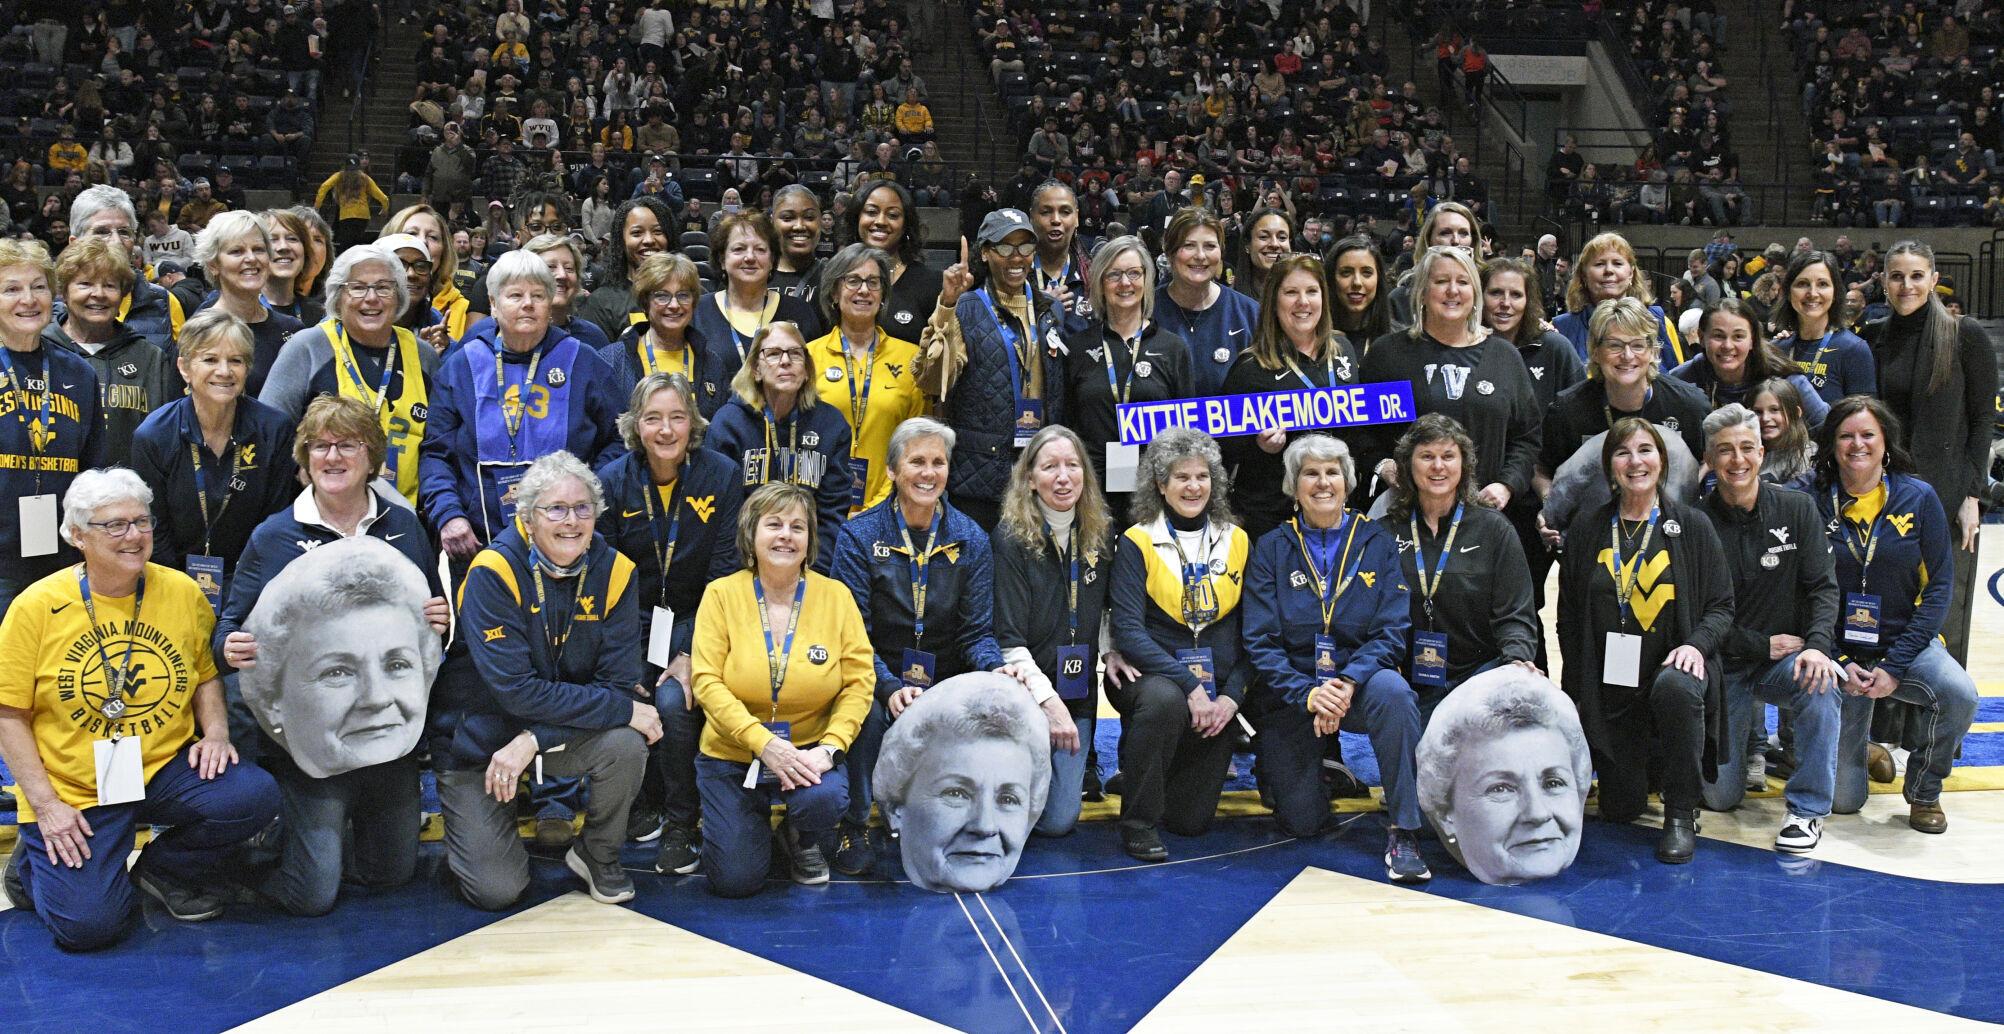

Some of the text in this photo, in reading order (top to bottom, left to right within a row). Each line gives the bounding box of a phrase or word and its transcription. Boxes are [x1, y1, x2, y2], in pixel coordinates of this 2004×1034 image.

[150, 240, 180, 252] WVU
[119, 363, 138, 376] KB
[27, 378, 45, 391] KB
[547, 371, 566, 384] KB
[412, 405, 428, 419] KB
[1119, 388, 1407, 443] KITTIE BLAKEMORE DR.
[802, 435, 819, 446] KB
[0, 454, 26, 472] OMEN'S
[230, 477, 246, 491] KB
[873, 545, 891, 557] KB
[1761, 556, 1779, 567] KB
[1290, 573, 1308, 587] KB
[58, 620, 188, 702] WEST VIRGINIA MOUNTAINEERS
[809, 648, 828, 661] KB
[1063, 659, 1082, 674] KB
[102, 698, 125, 719] KB
[70, 700, 181, 738] BASKETBALL
